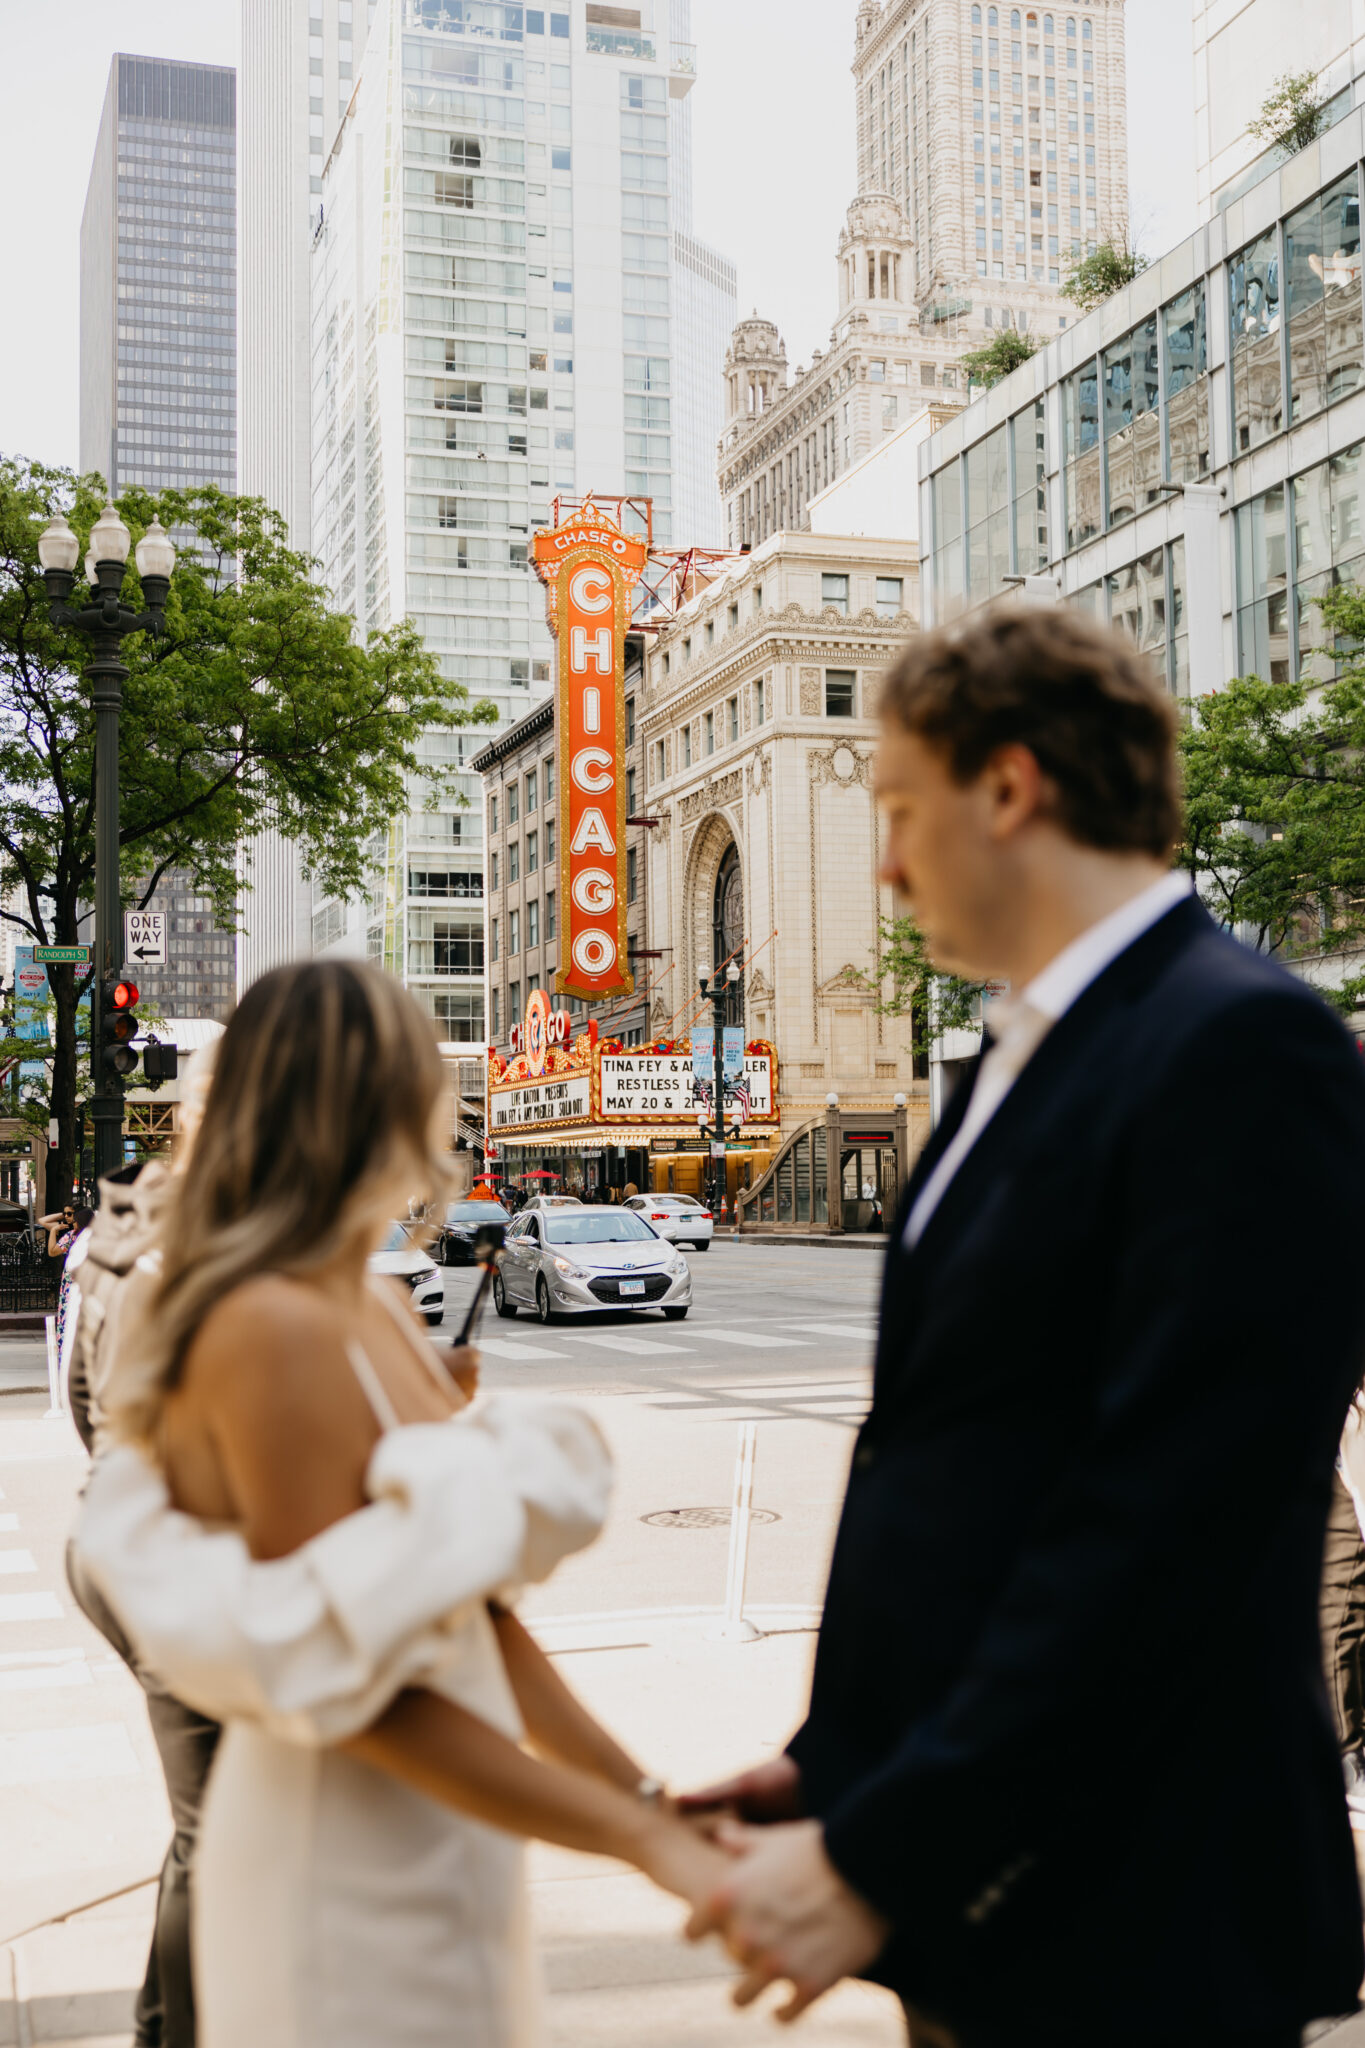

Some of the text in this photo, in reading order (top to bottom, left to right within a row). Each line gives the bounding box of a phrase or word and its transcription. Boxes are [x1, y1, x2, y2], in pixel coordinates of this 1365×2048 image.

[554, 530, 611, 550] CHASE
[570, 567, 616, 975] CHICAGO
[131, 916, 161, 929] ONE
[130, 931, 161, 943] WAY
[38, 950, 76, 959] RANDOLPH
[603, 1060, 633, 1072] TINA
[639, 1060, 662, 1072] FEY
[670, 1060, 679, 1072] &
[617, 1078, 680, 1091] RESTLESS
[523, 1087, 540, 1105] NATION
[545, 1083, 568, 1101] PRESENTS
[607, 1097, 633, 1109] MAY
[641, 1097, 658, 1109] 20
[664, 1097, 673, 1109] &
